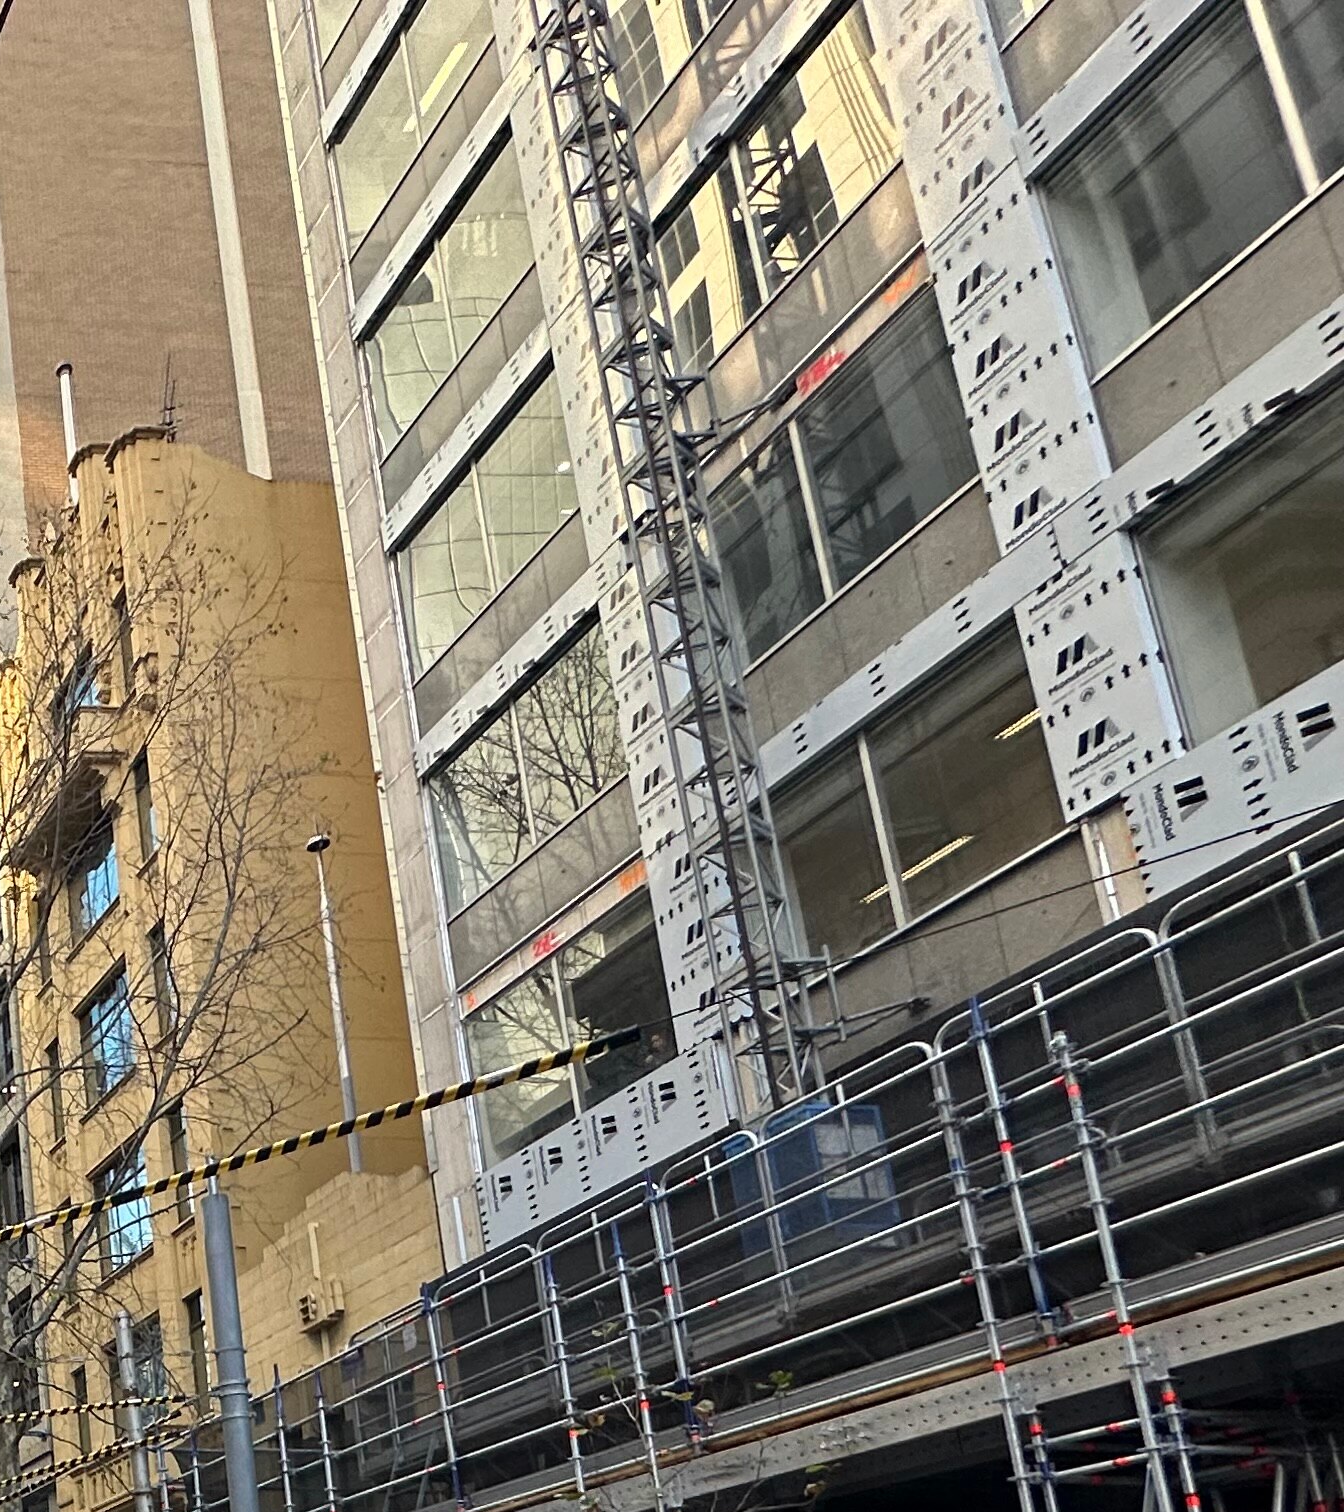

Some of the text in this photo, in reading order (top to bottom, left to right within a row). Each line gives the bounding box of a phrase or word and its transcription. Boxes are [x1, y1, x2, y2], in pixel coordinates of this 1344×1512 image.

[987, 418, 1047, 473] MondoClad
[1006, 497, 1067, 549] MondoClad
[1029, 564, 1093, 616] MondoClad
[1048, 647, 1114, 697] MondoClad
[1069, 732, 1136, 779] MondoClad
[1272, 711, 1301, 774] MondoClad
[1152, 783, 1177, 842] MondoClad
